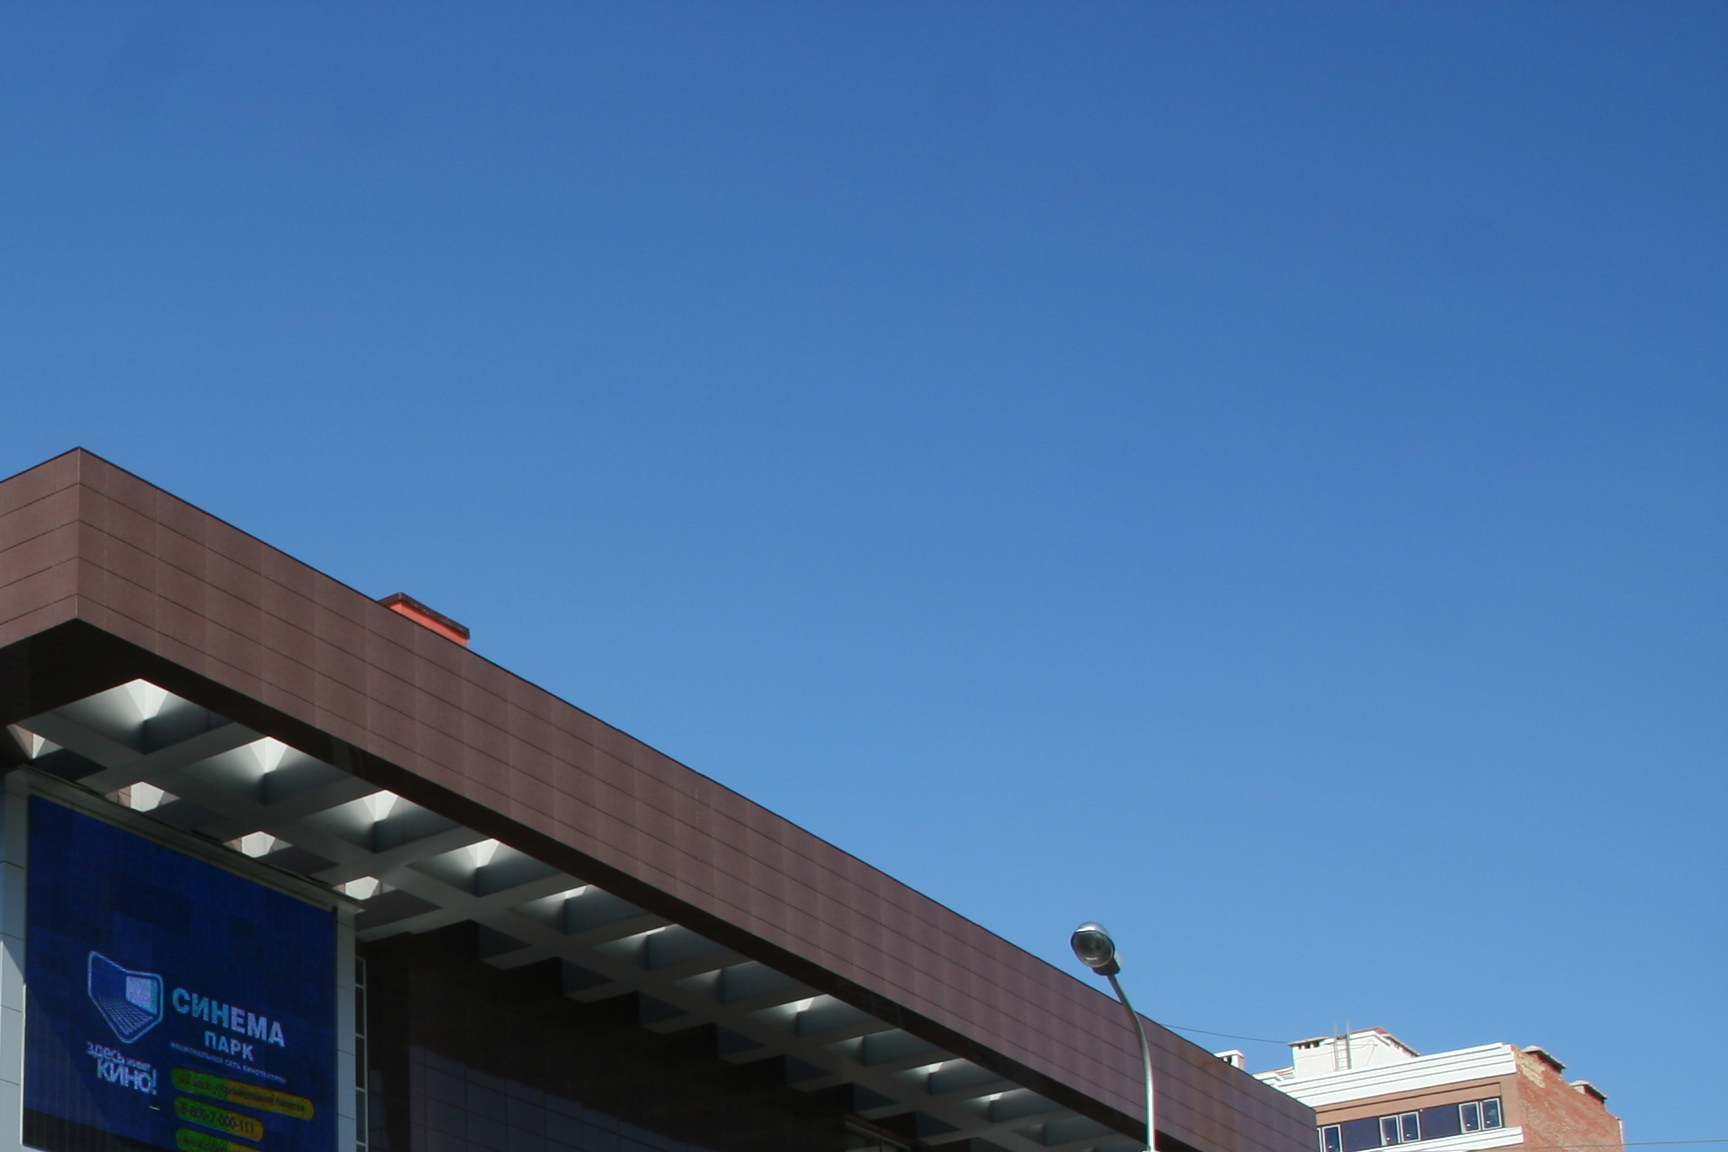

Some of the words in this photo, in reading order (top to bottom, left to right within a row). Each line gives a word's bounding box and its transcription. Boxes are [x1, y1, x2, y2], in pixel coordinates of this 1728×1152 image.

[172, 987, 286, 1048] СИНЕМА
[204, 1030, 254, 1062] ПАРК
[97, 1059, 157, 1095] КИНО!
